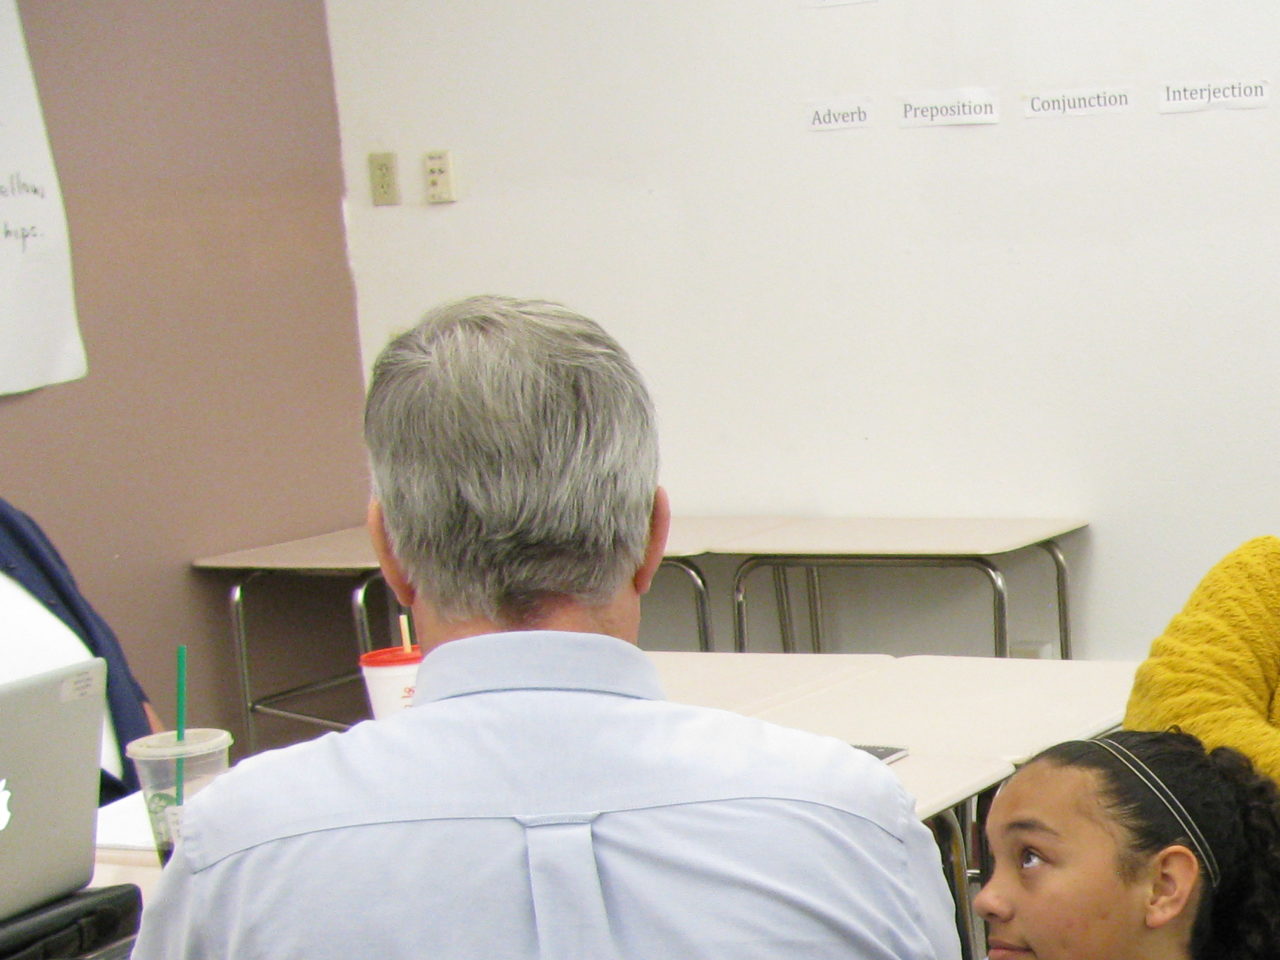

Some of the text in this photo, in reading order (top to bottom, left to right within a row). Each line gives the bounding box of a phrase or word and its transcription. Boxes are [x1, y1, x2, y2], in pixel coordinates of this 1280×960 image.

[1030, 92, 1129, 113] Conjunction
[1165, 82, 1265, 103] Interjection
[811, 106, 868, 125] Adverb
[903, 100, 994, 121] Preposition
